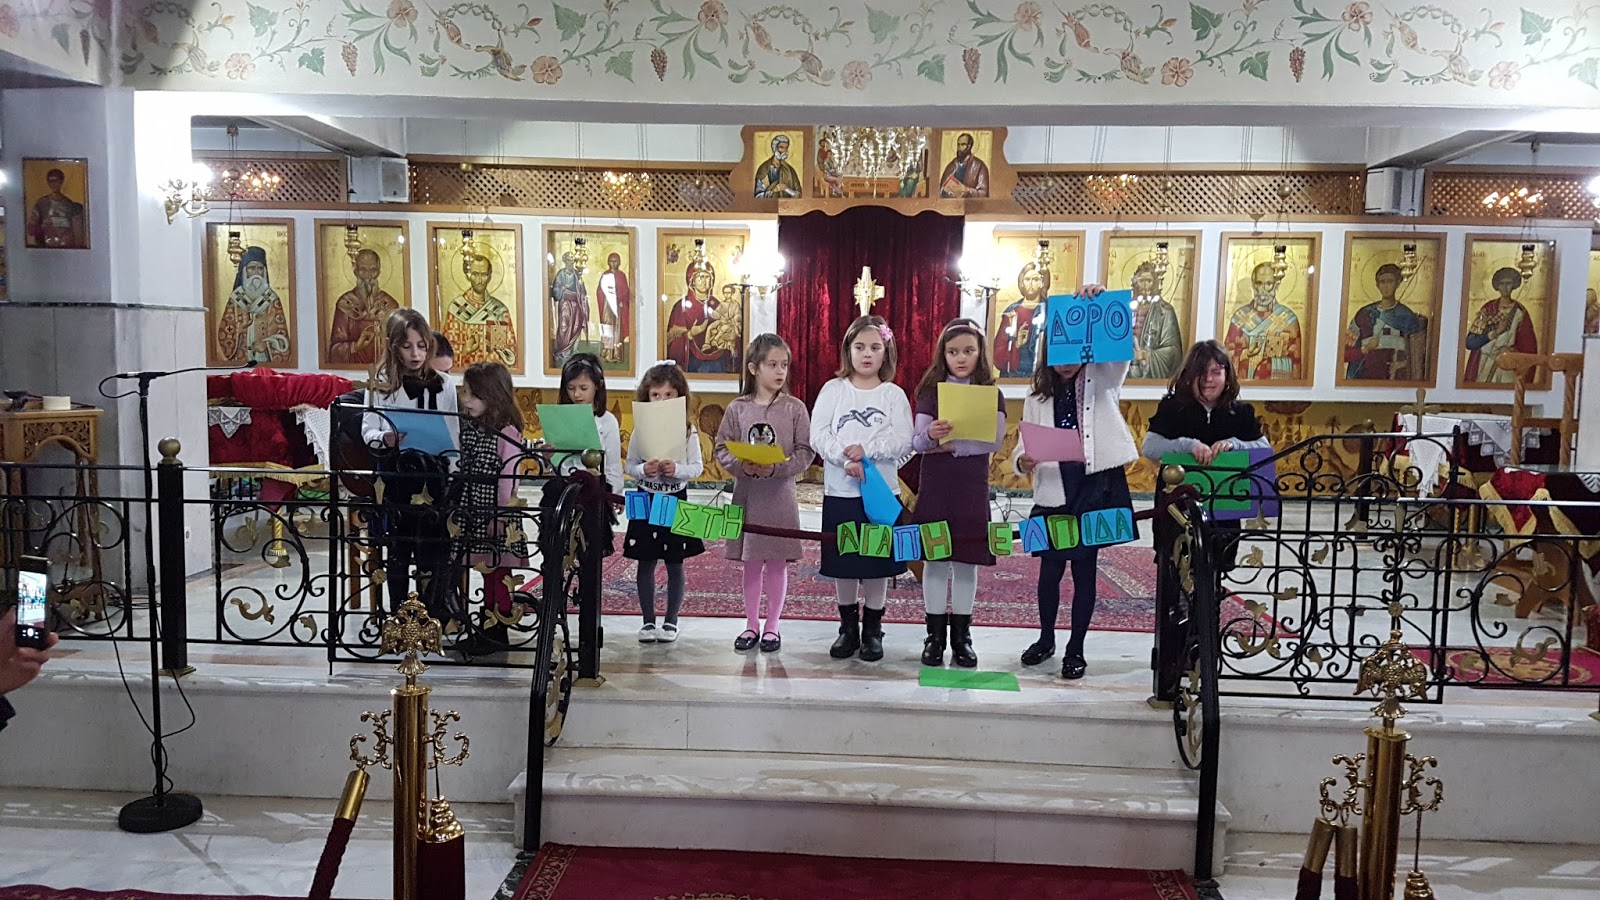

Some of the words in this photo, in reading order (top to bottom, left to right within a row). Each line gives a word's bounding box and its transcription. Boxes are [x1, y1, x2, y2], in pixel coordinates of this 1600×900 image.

[625, 491, 745, 538] ΠΙΣΤΗ
[840, 523, 951, 559] ΑΓΑΠΗ
[989, 508, 1134, 555] ΕΛΠΙΔΑ
